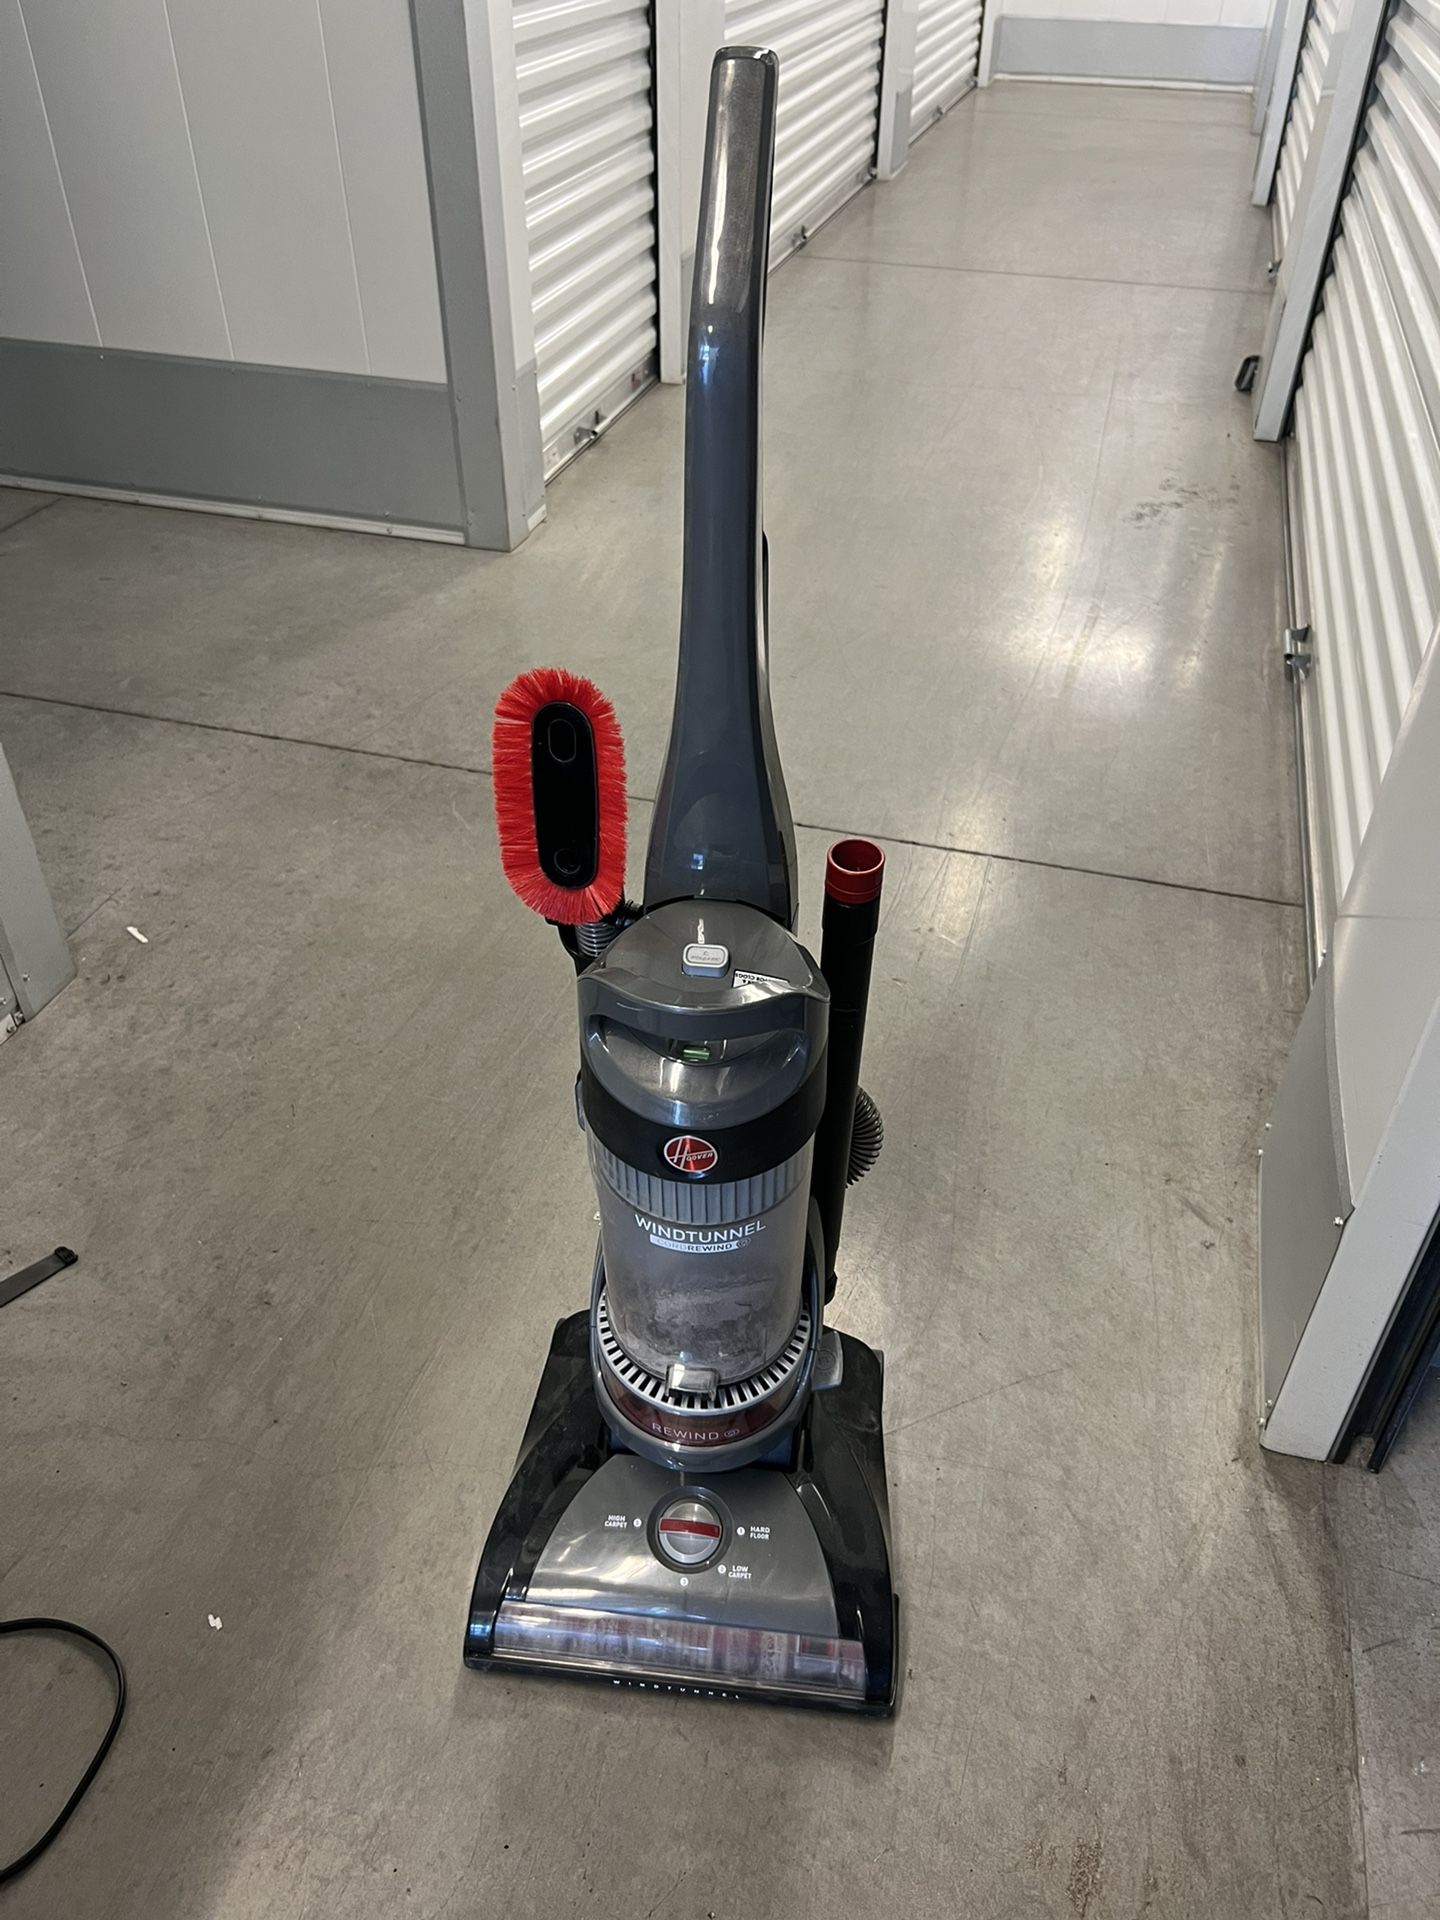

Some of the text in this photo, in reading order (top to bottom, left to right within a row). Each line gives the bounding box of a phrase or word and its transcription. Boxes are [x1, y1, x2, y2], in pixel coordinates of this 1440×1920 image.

[635, 1214, 766, 1243] WINDTUNNEL
[652, 1422, 719, 1440] REWIND
[608, 1514, 626, 1522] HIGH
[604, 1520, 628, 1528] CARPET
[750, 1525, 770, 1533] HARD
[750, 1532, 769, 1540] FLOOR
[728, 1571, 752, 1579] CARPET
